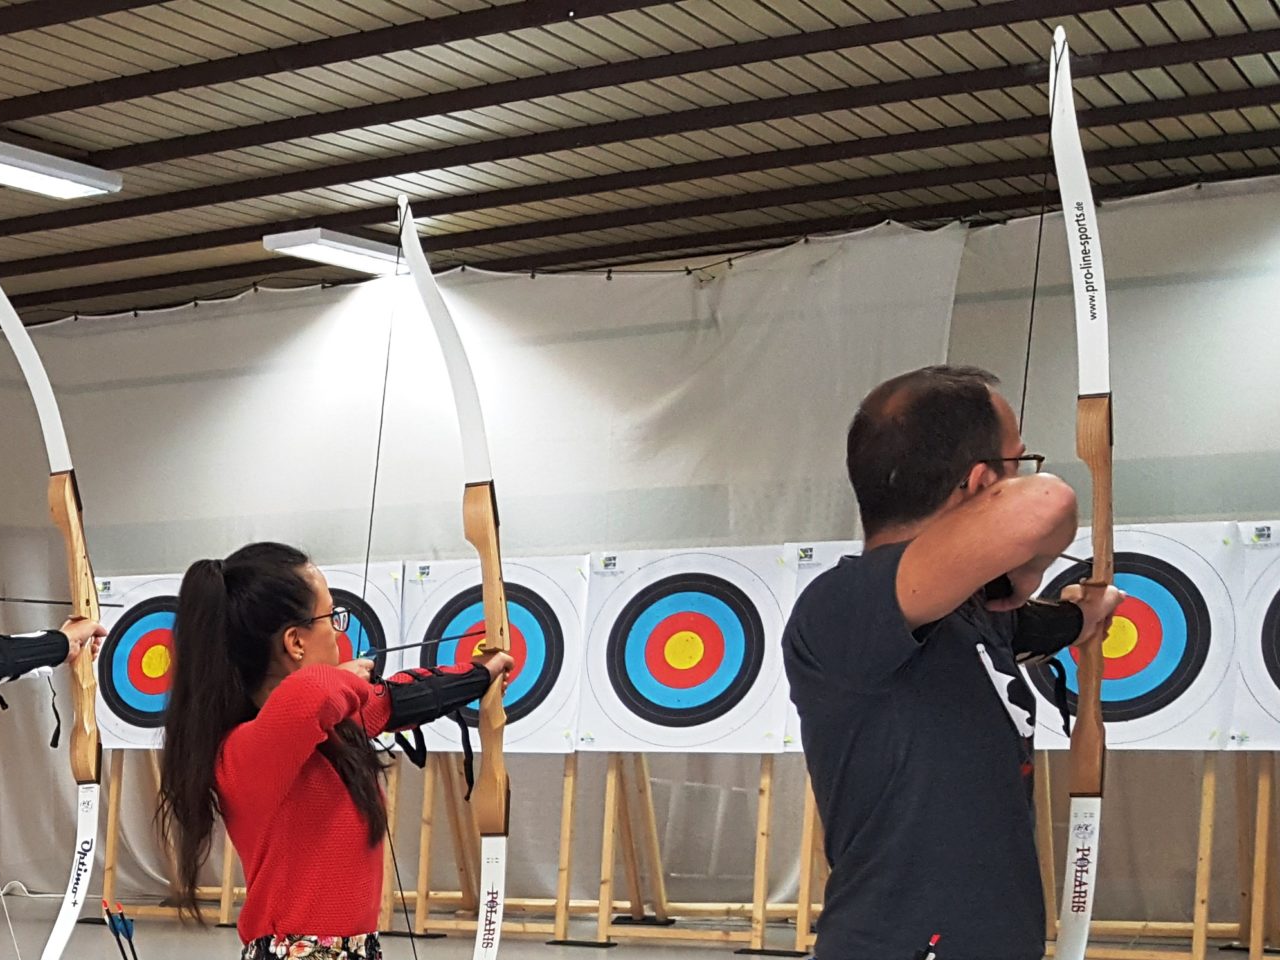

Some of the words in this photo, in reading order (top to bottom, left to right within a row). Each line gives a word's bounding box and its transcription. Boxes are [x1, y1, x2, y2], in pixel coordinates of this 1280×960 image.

[1075, 201, 1098, 321] www.pro-line-sports.de
[1071, 846, 1092, 914] POLARIS
[481, 890, 499, 949] POLARIS
